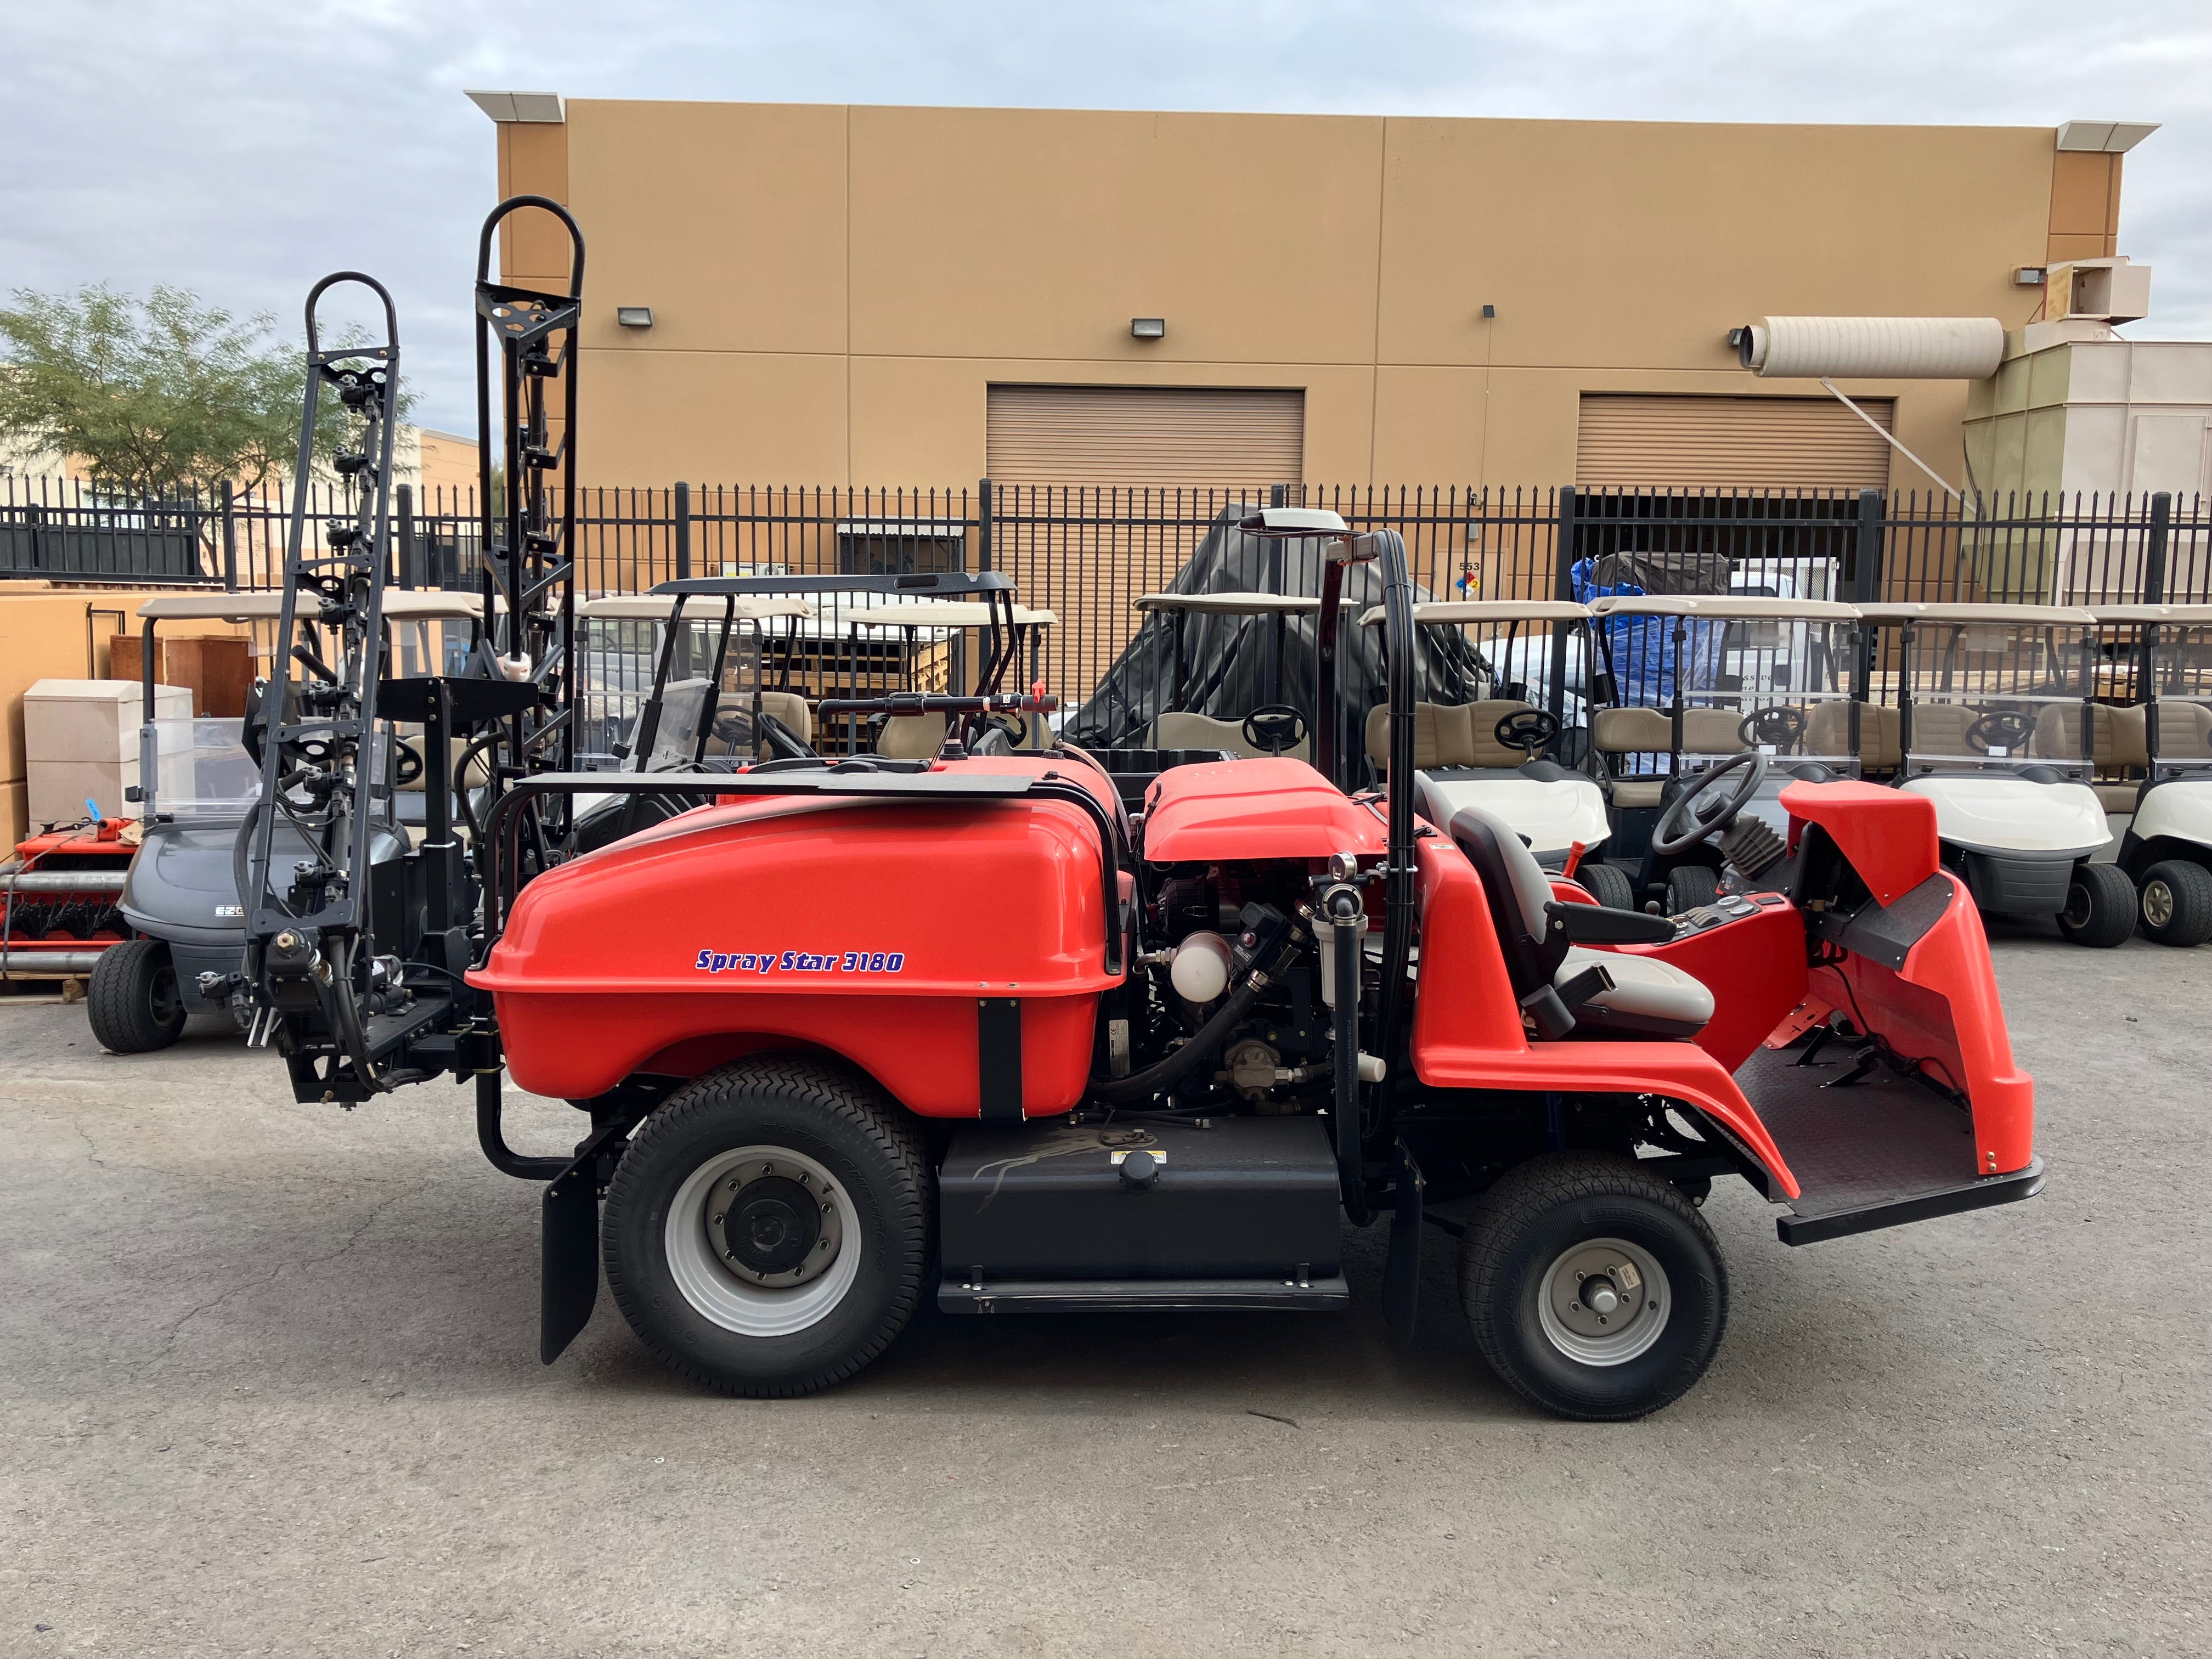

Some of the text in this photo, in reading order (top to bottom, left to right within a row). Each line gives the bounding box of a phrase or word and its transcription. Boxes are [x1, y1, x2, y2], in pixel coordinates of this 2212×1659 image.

[696, 950, 905, 974] Spray Star 3180
[759, 1123, 837, 1150] ULTRA
